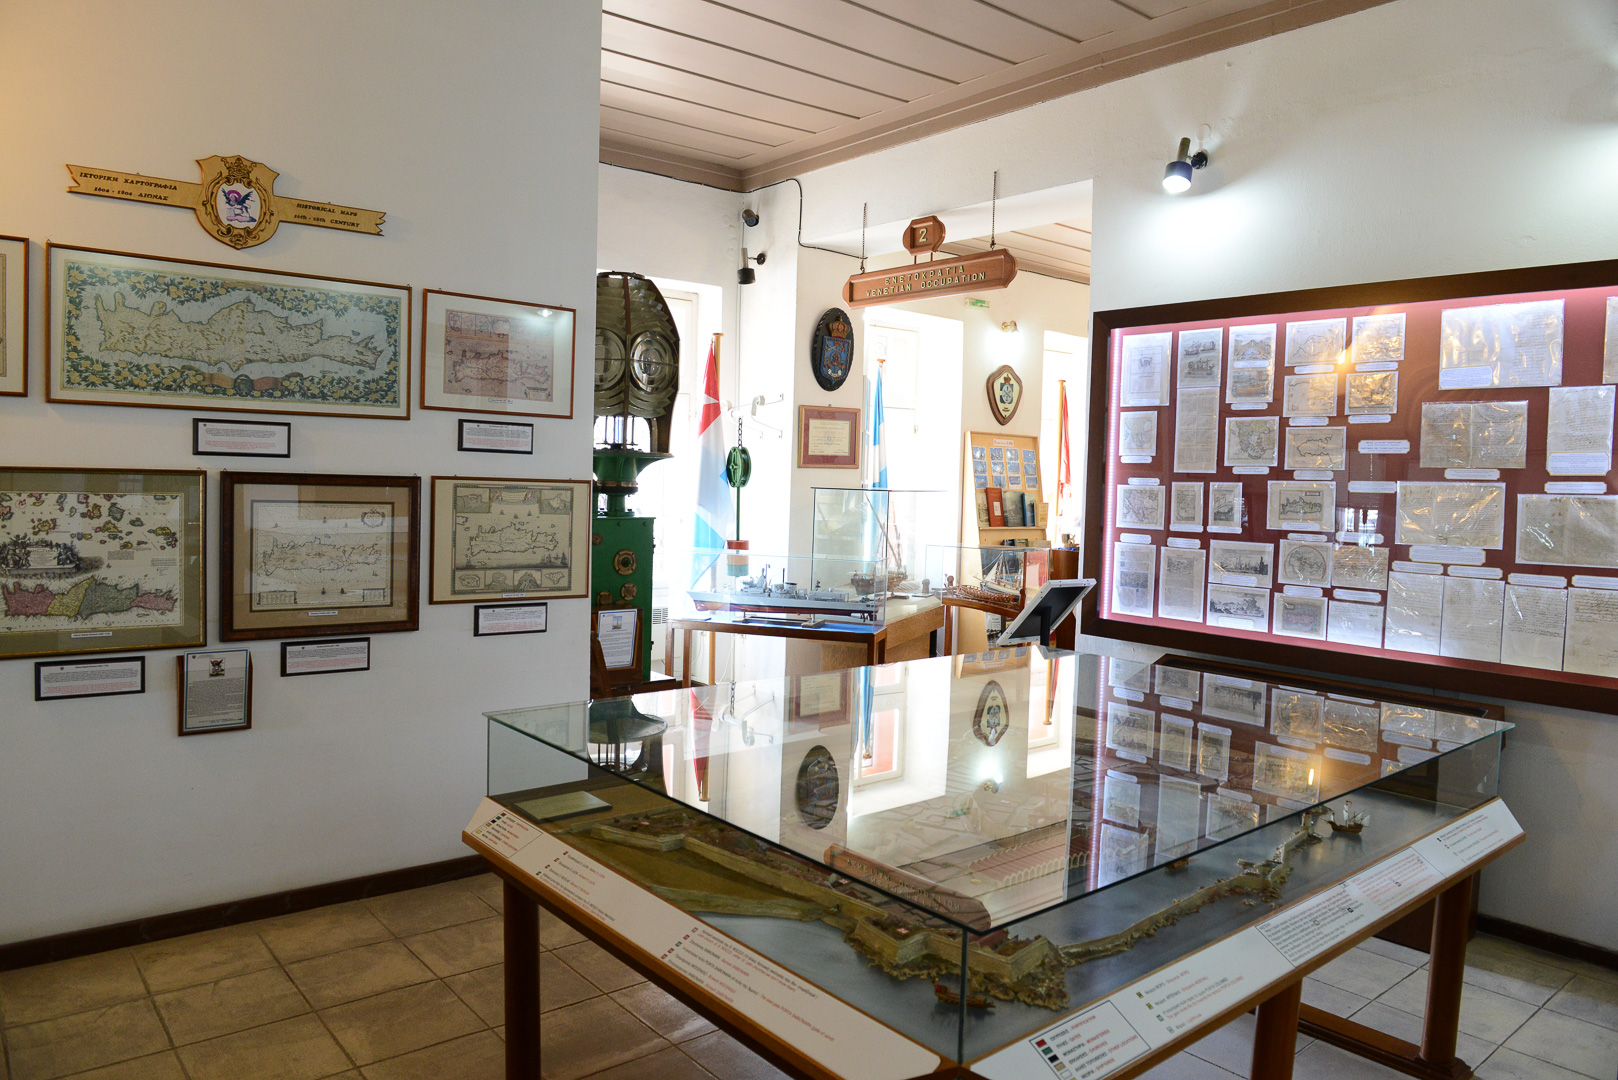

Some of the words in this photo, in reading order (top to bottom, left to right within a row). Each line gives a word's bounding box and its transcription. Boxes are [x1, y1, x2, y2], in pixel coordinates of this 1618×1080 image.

[80, 172, 118, 182] ΙΣΤΟΡΙΚΗ
[296, 203, 336, 213] HISTORICAL
[330, 219, 360, 228] CENTURY
[919, 228, 928, 242] 2
[866, 284, 912, 296] VENETIAN
[920, 272, 986, 288] OCCUPATION
